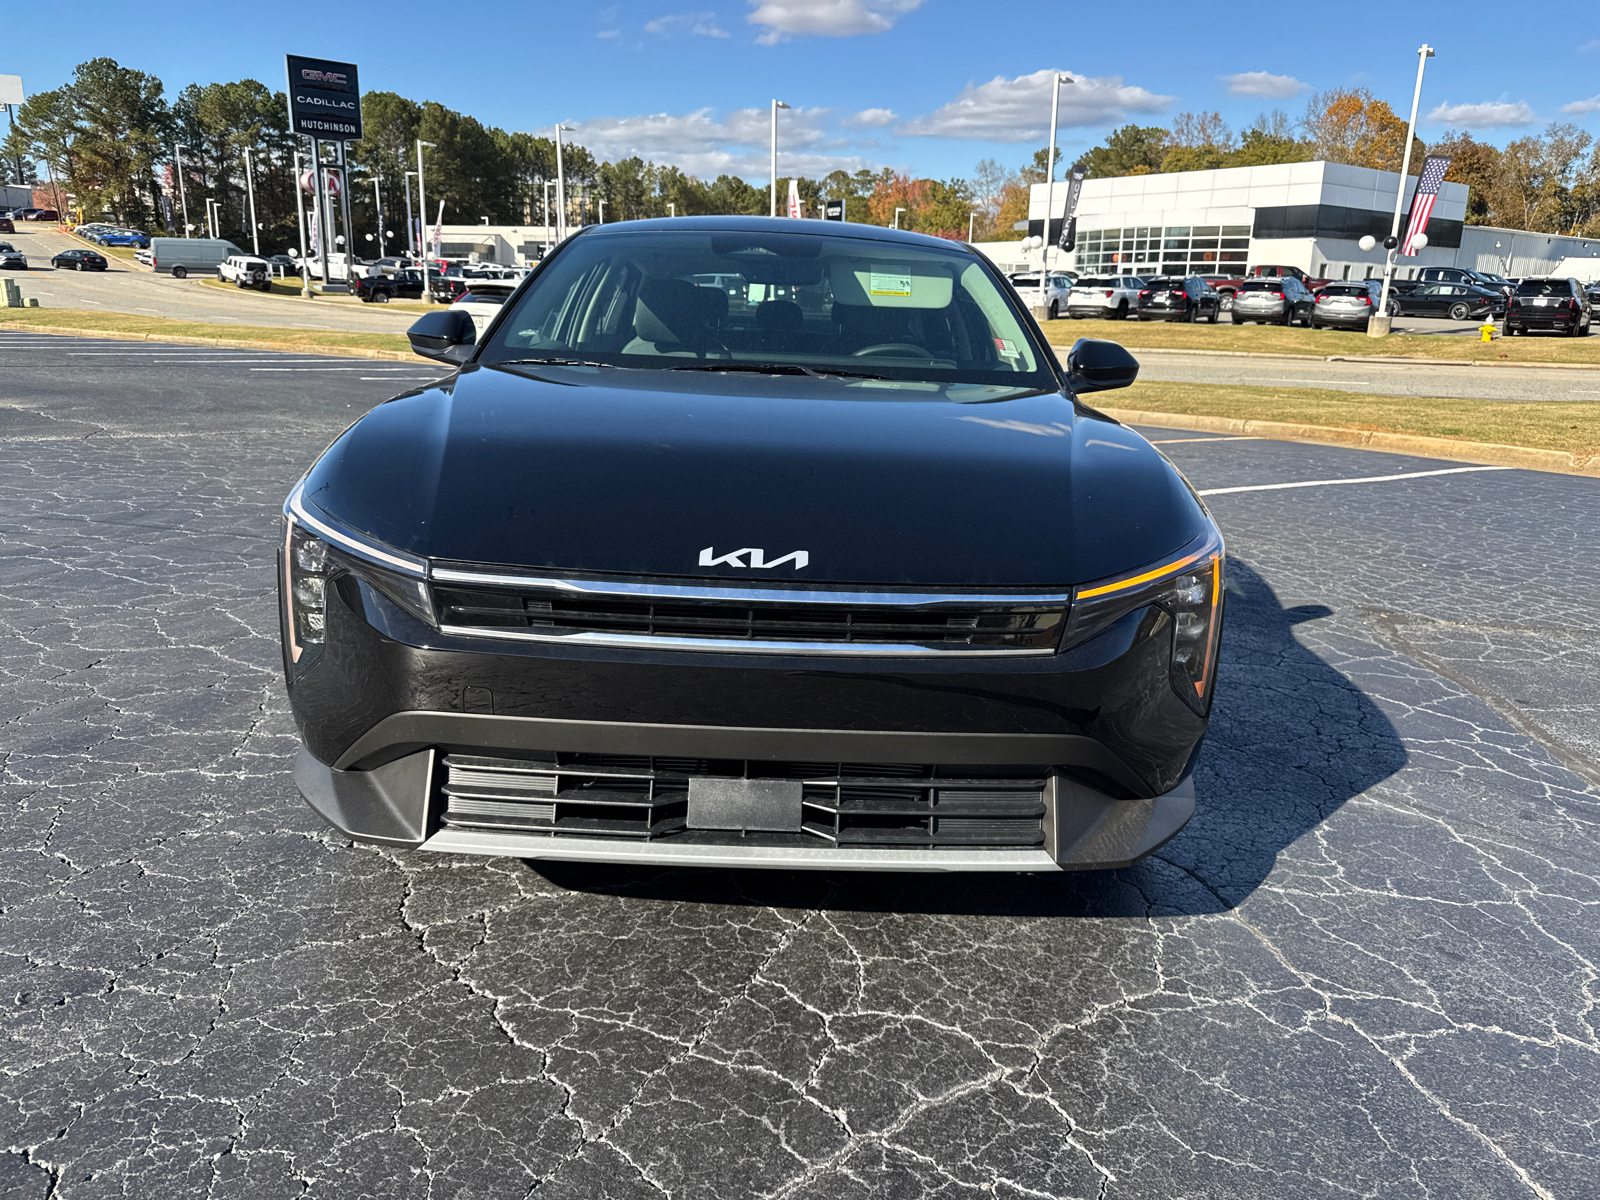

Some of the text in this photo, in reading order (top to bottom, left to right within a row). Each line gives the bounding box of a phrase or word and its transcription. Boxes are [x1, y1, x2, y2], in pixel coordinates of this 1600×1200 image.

[302, 69, 347, 84] GMC
[297, 95, 355, 110] CADILLAC
[301, 119, 356, 133] HUTCHINSON
